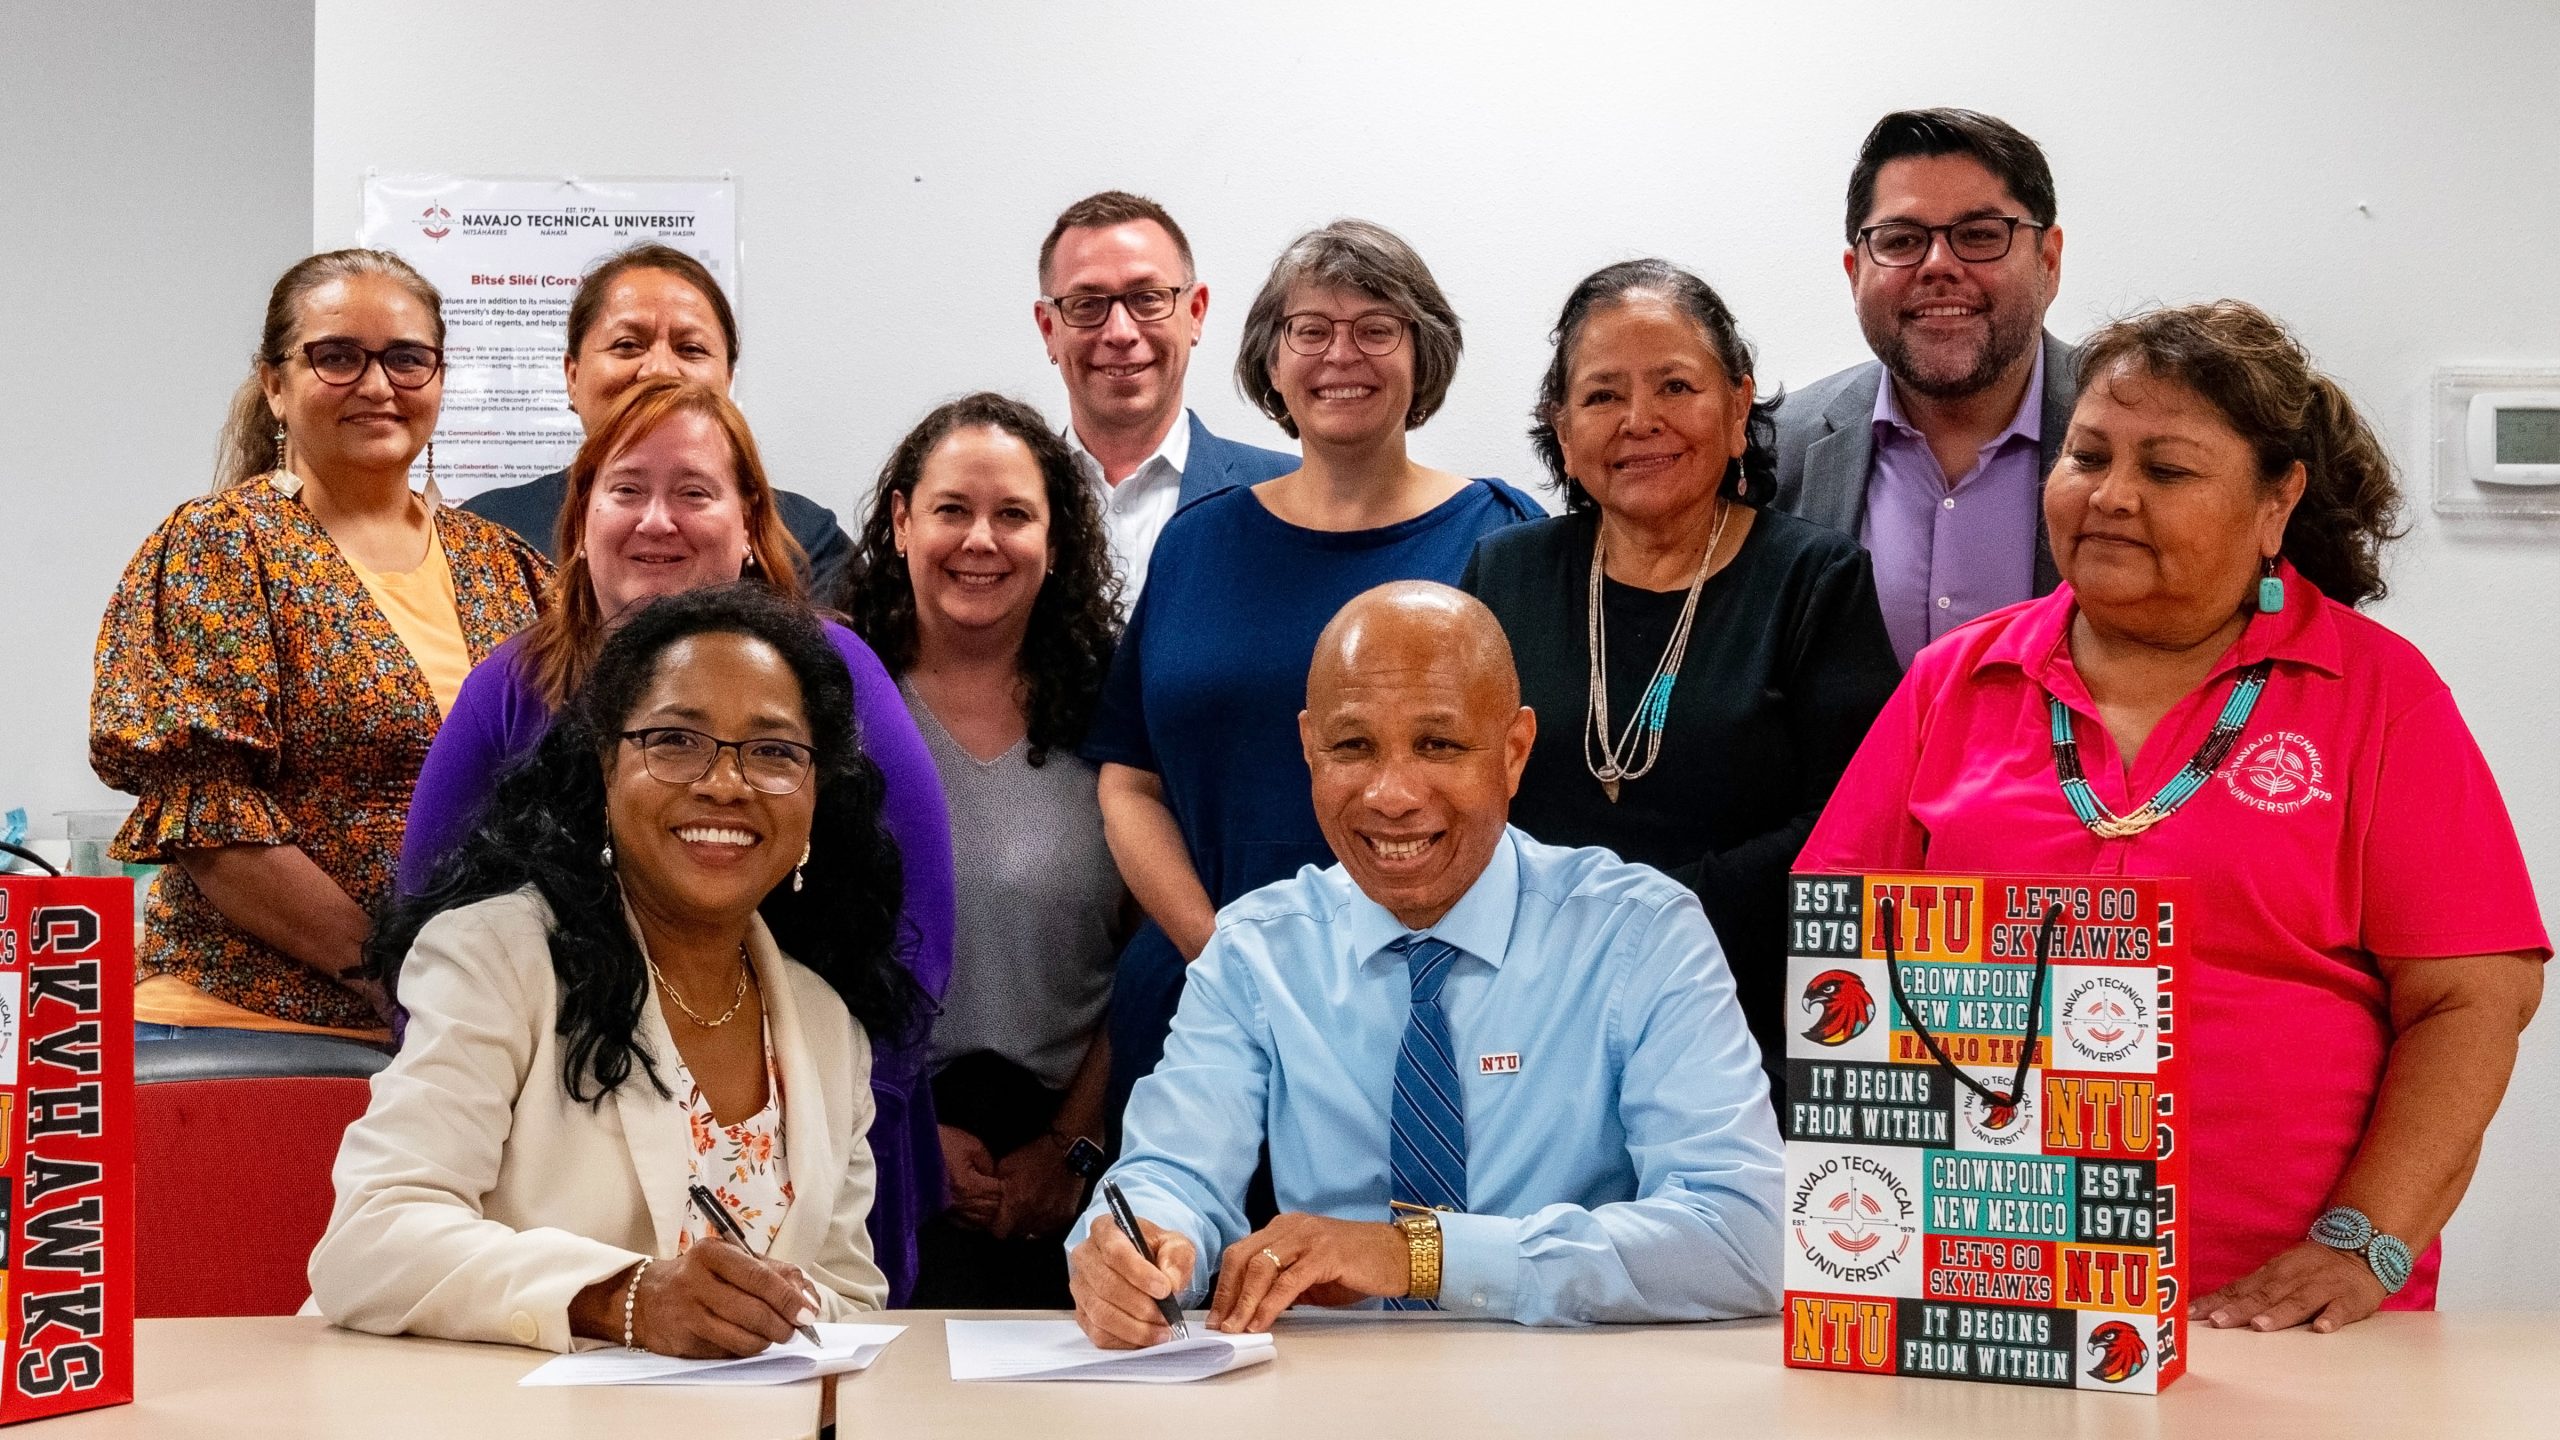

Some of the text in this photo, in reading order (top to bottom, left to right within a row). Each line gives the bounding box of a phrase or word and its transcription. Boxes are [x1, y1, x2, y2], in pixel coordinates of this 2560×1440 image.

[462, 214, 695, 228] NAVAJO TECHNICAL UNIVERSITY
[471, 274, 505, 286] Bitsé
[541, 275, 577, 287] (Core
[449, 308, 490, 316] university's
[491, 308, 530, 317] day-to-day
[480, 297, 487, 305] in
[488, 297, 518, 305] addition
[539, 299, 569, 307] mission,
[494, 320, 524, 328] regents,
[541, 320, 557, 328] help
[2217, 769, 2239, 779] EST.
[2230, 731, 2324, 784] NAVAJO TECHNICAL
[2230, 786, 2301, 814] UNIVERSITY
[2307, 785, 2333, 802] 1979
[1793, 881, 1859, 914] EST.
[2005, 886, 2138, 922] LET'S GO
[1792, 920, 1859, 951] 1979
[1871, 883, 1976, 955] NTU
[1990, 924, 2152, 960] SKYHAWKS
[1899, 966, 2037, 998] CROWNPOIN
[2062, 977, 2148, 1020] NAVAJO TECHNICAL
[1481, 1055, 1518, 1072] NTU
[2071, 1038, 2139, 1063] UNIVERSITY
[1810, 1066, 1931, 1104] IT BEGINS
[1792, 1103, 1949, 1142] FROM WITHIN
[2046, 1077, 2156, 1152] NTU
[16, 903, 105, 1399] SKYHAWKS
[1971, 1125, 2026, 1146] UNIVERSITY
[1792, 1155, 1914, 1220] NAVAJO TECHNICAL
[1932, 1156, 2068, 1196] CROWNPOINT
[2081, 1165, 2153, 1200] EST.
[1792, 1219, 1807, 1227] EST.
[1900, 1226, 1916, 1234] 1979
[1932, 1196, 2069, 1237] NEW MEXICO
[2081, 1203, 2153, 1239] 1979
[1805, 1245, 1901, 1283] UNIVERSITY
[1939, 1240, 2042, 1271] LET'S GO
[1929, 1270, 2053, 1302] SKYHAWKS
[2063, 1248, 2151, 1308] NTU
[1791, 1297, 1890, 1367] NTU
[1922, 1305, 2052, 1345] IT BEGINS
[1903, 1339, 2070, 1381] FROM WITHIN
